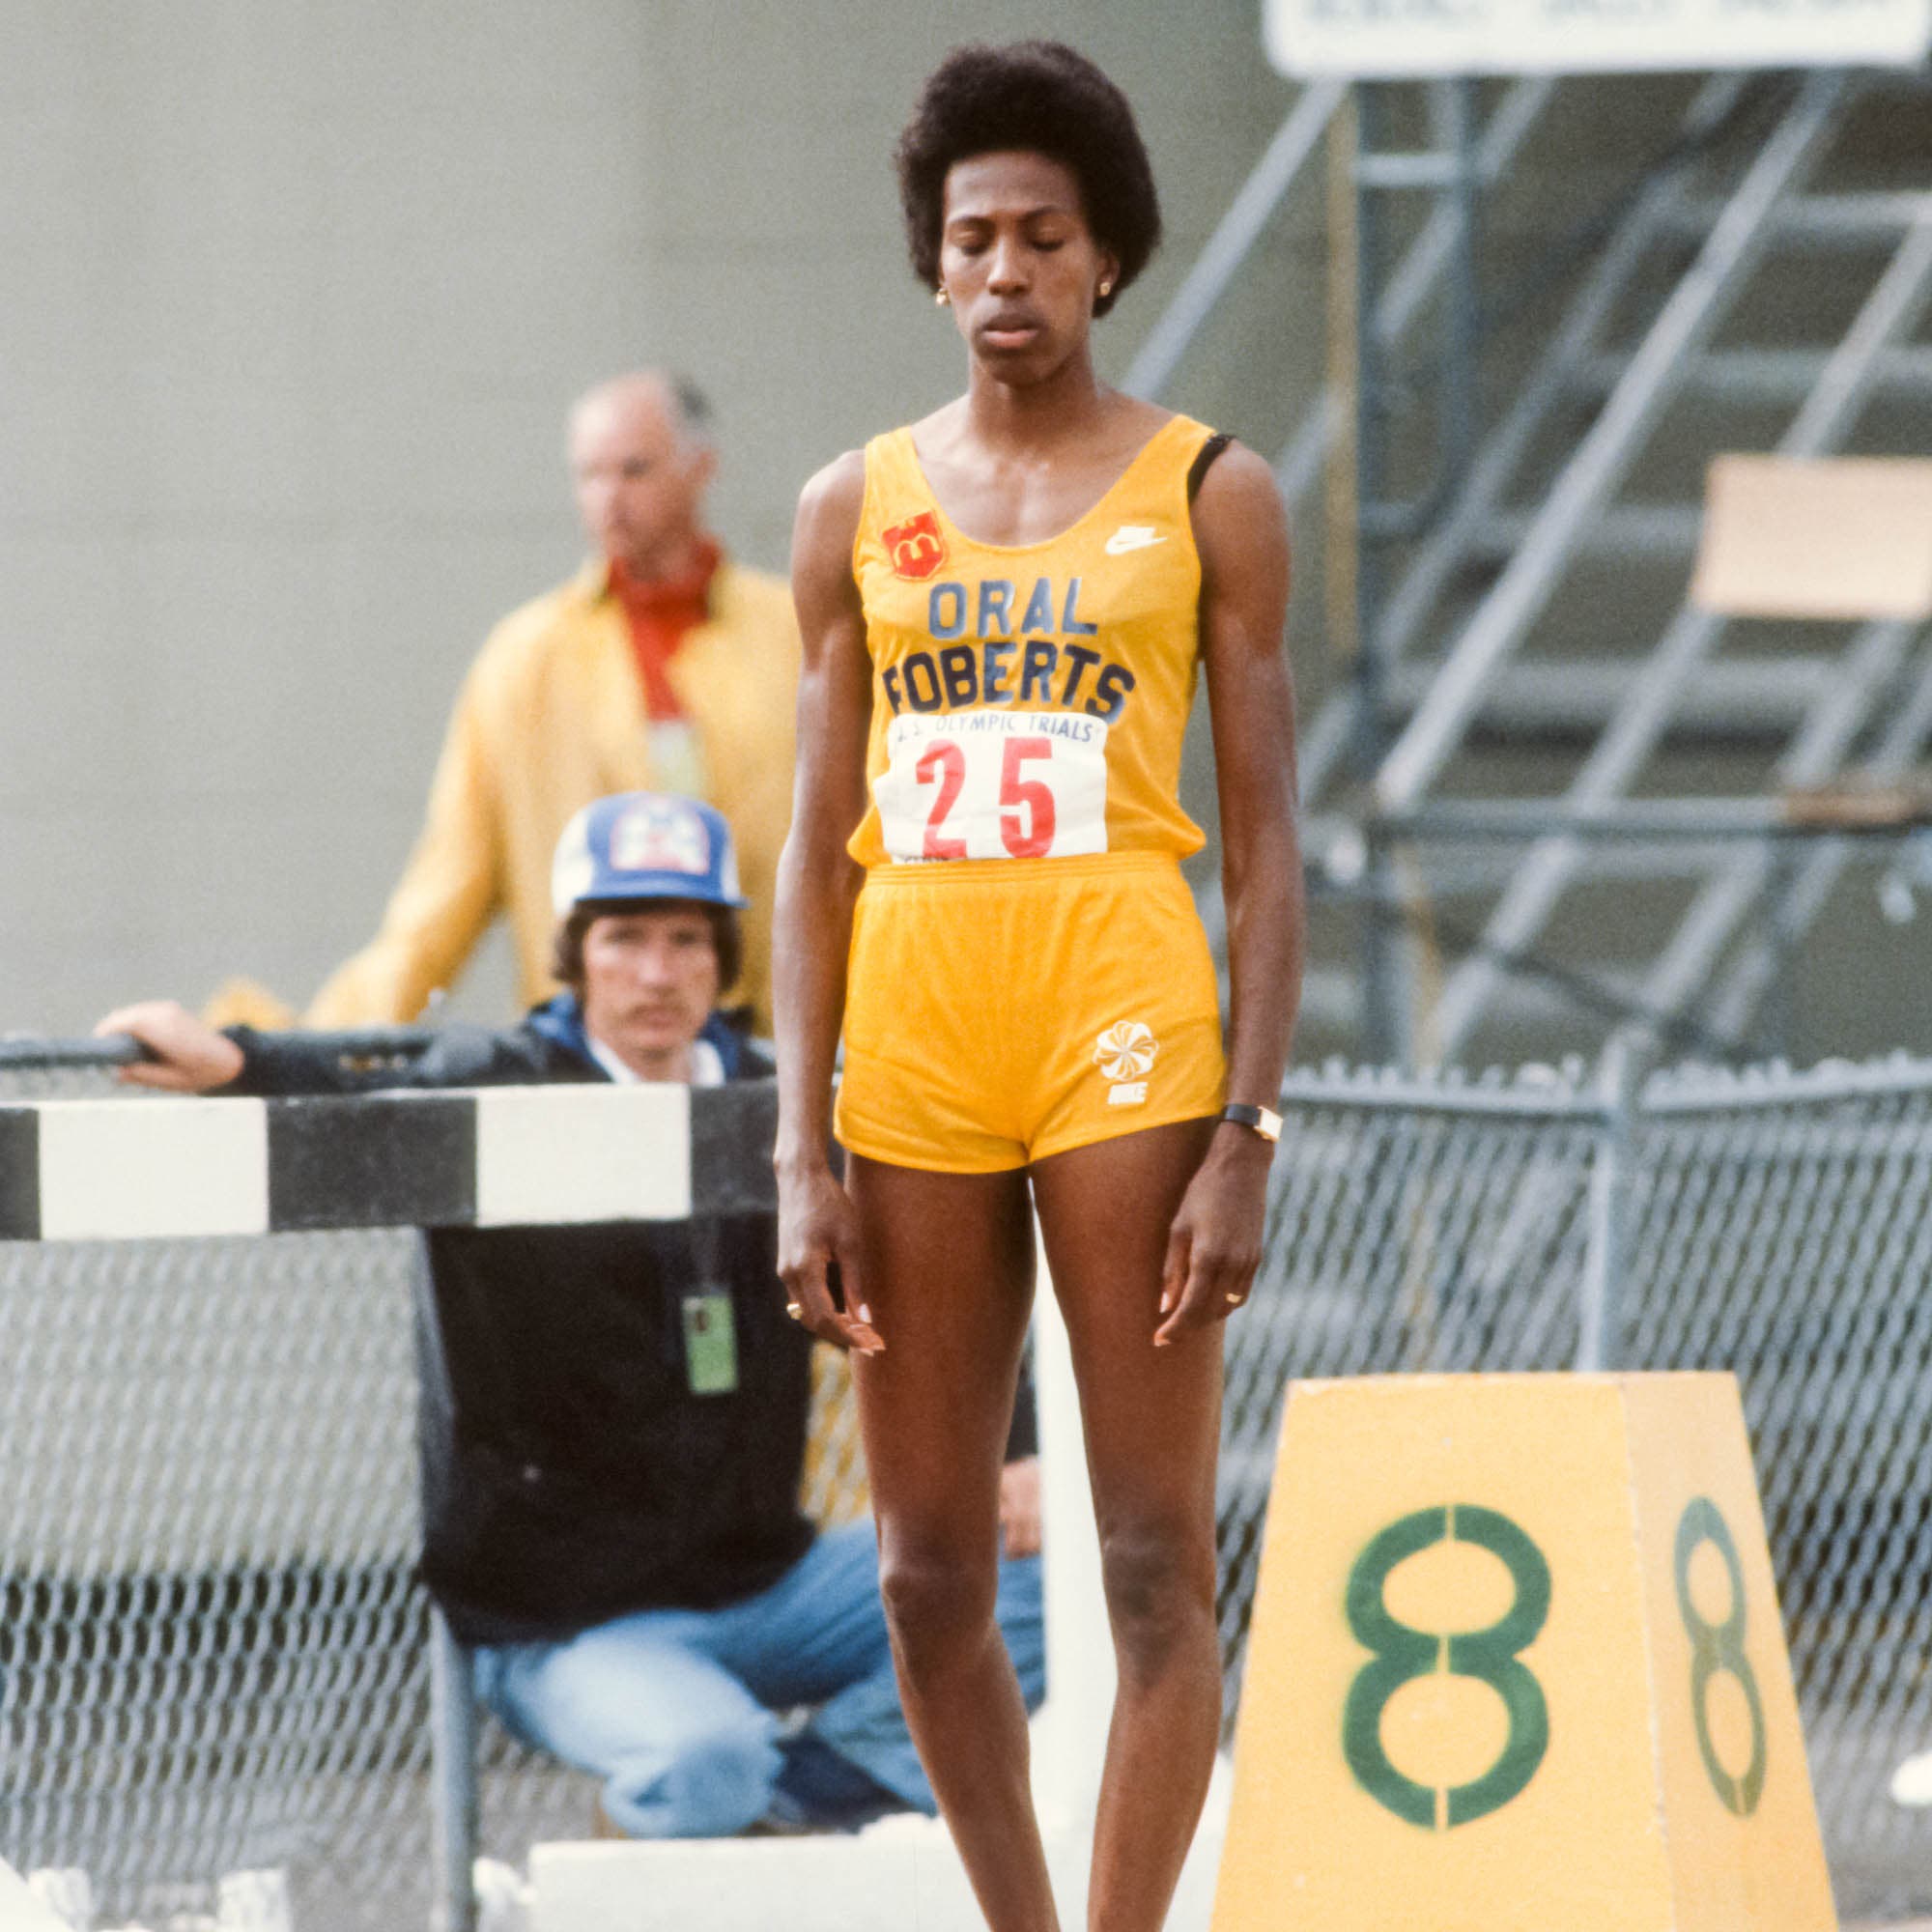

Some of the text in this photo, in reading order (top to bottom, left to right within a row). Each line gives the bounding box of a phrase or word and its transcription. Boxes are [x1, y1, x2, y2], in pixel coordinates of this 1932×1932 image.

[928, 577, 1098, 639] ORAL
[934, 714, 1013, 733] OLYMPIC
[1029, 715, 1094, 743] TRIALS
[916, 739, 1056, 859] 25
[1341, 1502, 1552, 1833] 8
[1672, 1495, 1767, 1819] 8
